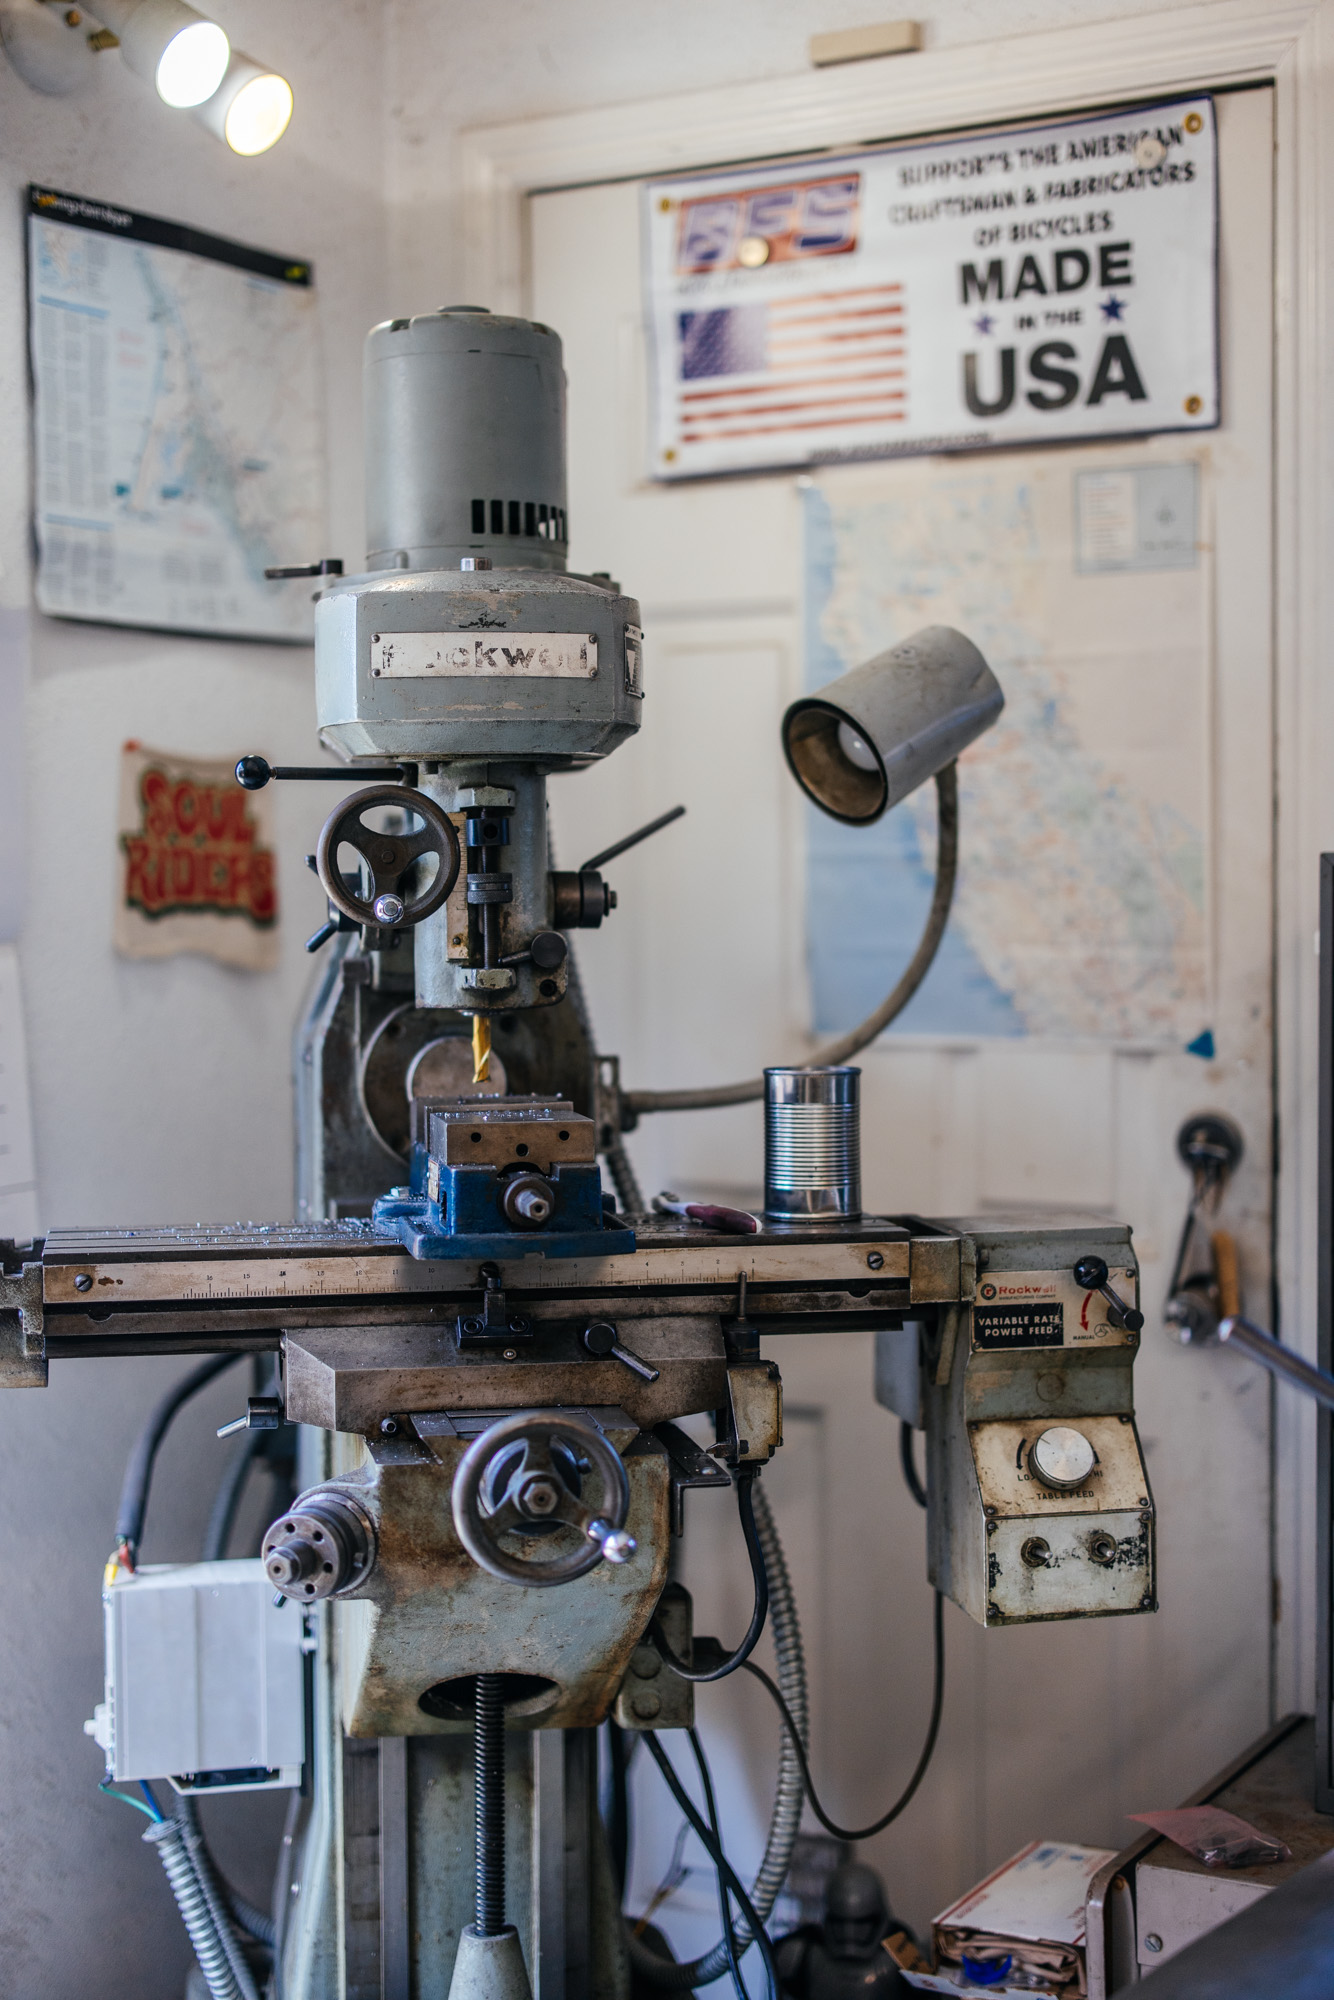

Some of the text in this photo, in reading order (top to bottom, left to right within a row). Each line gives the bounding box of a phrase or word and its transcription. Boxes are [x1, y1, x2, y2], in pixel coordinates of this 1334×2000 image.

[898, 150, 1013, 188] SUPPORTS
[1016, 141, 1060, 170] THE
[1023, 183, 1039, 206] &
[1043, 161, 1197, 201] FABRICATORS
[974, 210, 1115, 248] OF BICYCLES
[960, 241, 1133, 305] MADE
[1017, 310, 1083, 331] IN THE
[963, 334, 1148, 418] USA
[978, 1314, 1061, 1326] VARIABLE RATE
[985, 1326, 1054, 1337] POWER FEED
[1036, 1490, 1094, 1500] TABLE FEED
